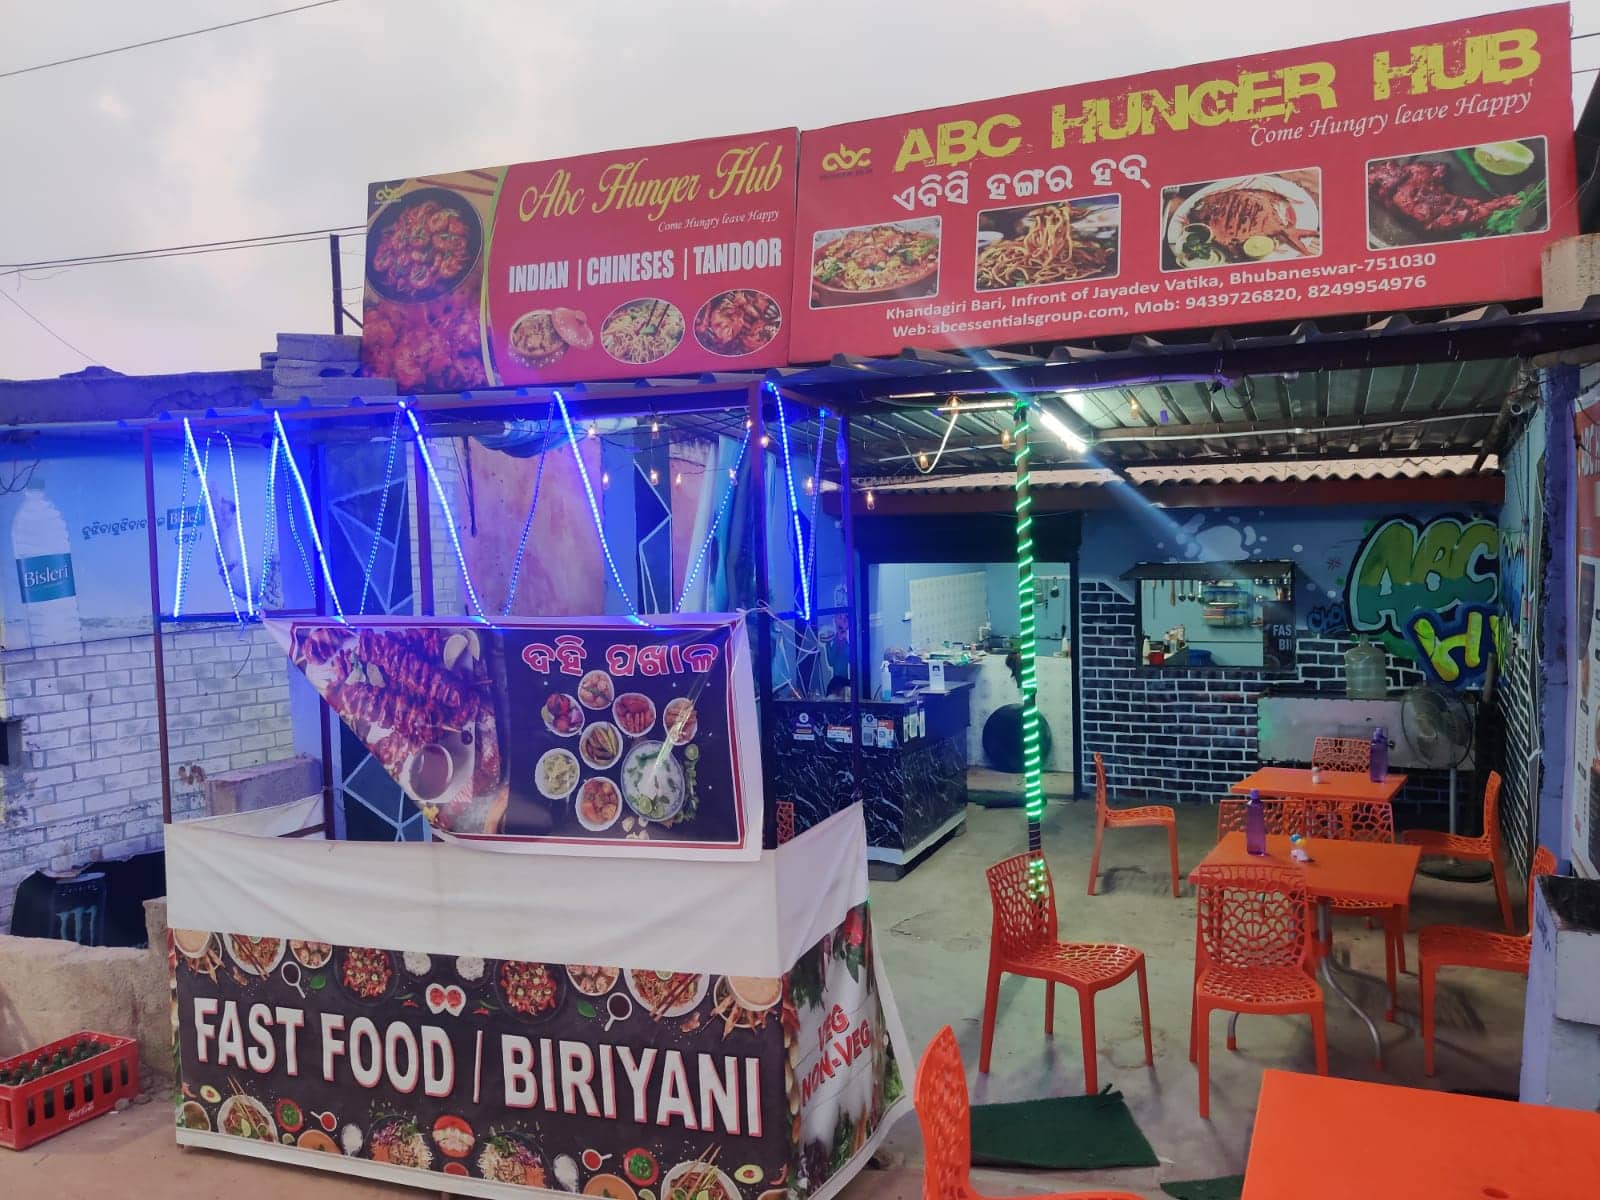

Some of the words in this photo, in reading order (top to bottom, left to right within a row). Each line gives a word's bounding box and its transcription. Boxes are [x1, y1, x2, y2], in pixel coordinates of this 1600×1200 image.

[893, 113, 1023, 173] ABC
[1051, 61, 1337, 149] HUNGER
[1373, 28, 1541, 101] HUB
[1250, 126, 1303, 147] Come
[1307, 112, 1389, 138] Hungry
[1395, 103, 1448, 125] leave
[1453, 90, 1532, 118] Happy
[519, 168, 585, 222] Abc
[591, 158, 700, 221] Hunger
[708, 142, 783, 202] Hub
[658, 221, 682, 232] Come
[684, 216, 720, 229] Hungry
[722, 213, 745, 224] leave
[748, 209, 780, 221] Happy
[508, 261, 569, 293] INDIAN
[586, 249, 675, 287] CHINESES
[693, 237, 782, 276] TANDOOR
[886, 302, 967, 321] Khandagiri
[971, 297, 1006, 311] Bari,
[1011, 289, 1067, 307] Infront
[1071, 287, 1089, 300] of
[1092, 282, 1159, 301] Jayadev
[1165, 275, 1224, 292] Vatika,
[1229, 252, 1437, 285] Bhubaneswar-751030
[1134, 300, 1180, 315] Mob:
[1185, 287, 1302, 310] 9439726820,
[1307, 275, 1427, 298] 8249954976
[24, 564, 69, 588] Bisleri
[1272, 624, 1294, 637] FAS
[818, 1004, 850, 1052] VEG
[193, 997, 305, 1076] FAST
[320, 1012, 456, 1098] FOOD
[501, 1032, 764, 1139] BIRIYANI
[802, 1019, 871, 1107] NON-VEG
